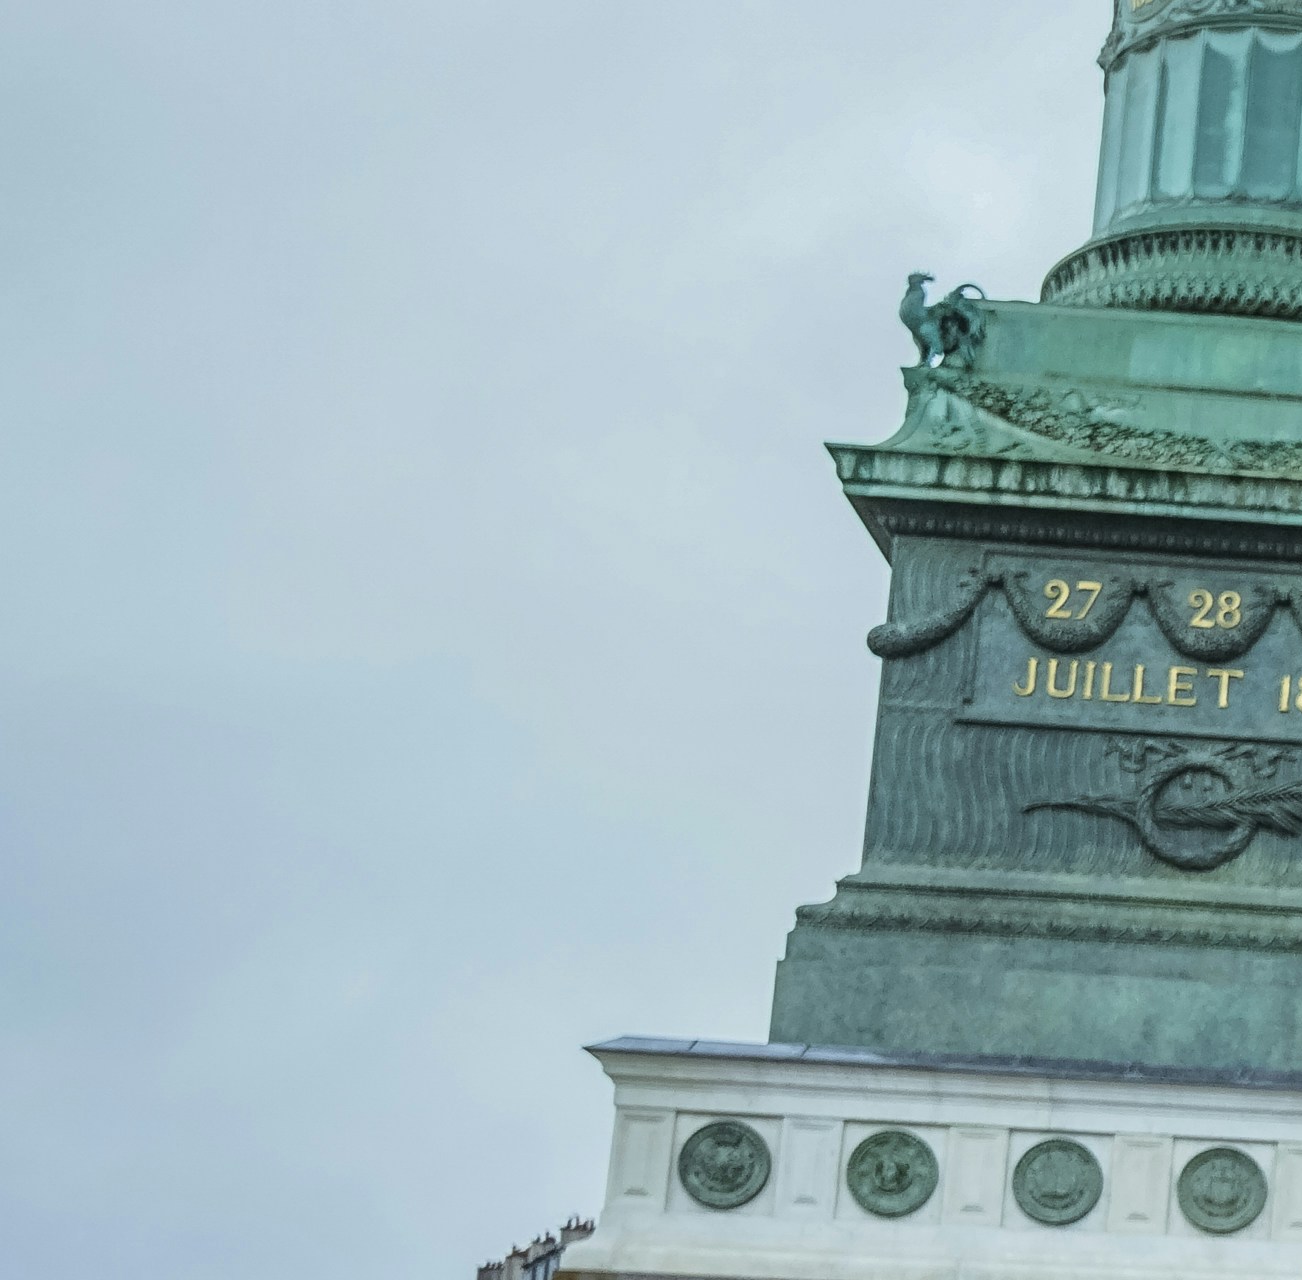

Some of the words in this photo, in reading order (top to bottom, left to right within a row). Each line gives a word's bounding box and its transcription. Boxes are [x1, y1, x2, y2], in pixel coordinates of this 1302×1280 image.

[1044, 579, 1102, 621] 27
[1188, 588, 1242, 629] 28
[1013, 657, 1244, 709] JUILLET
